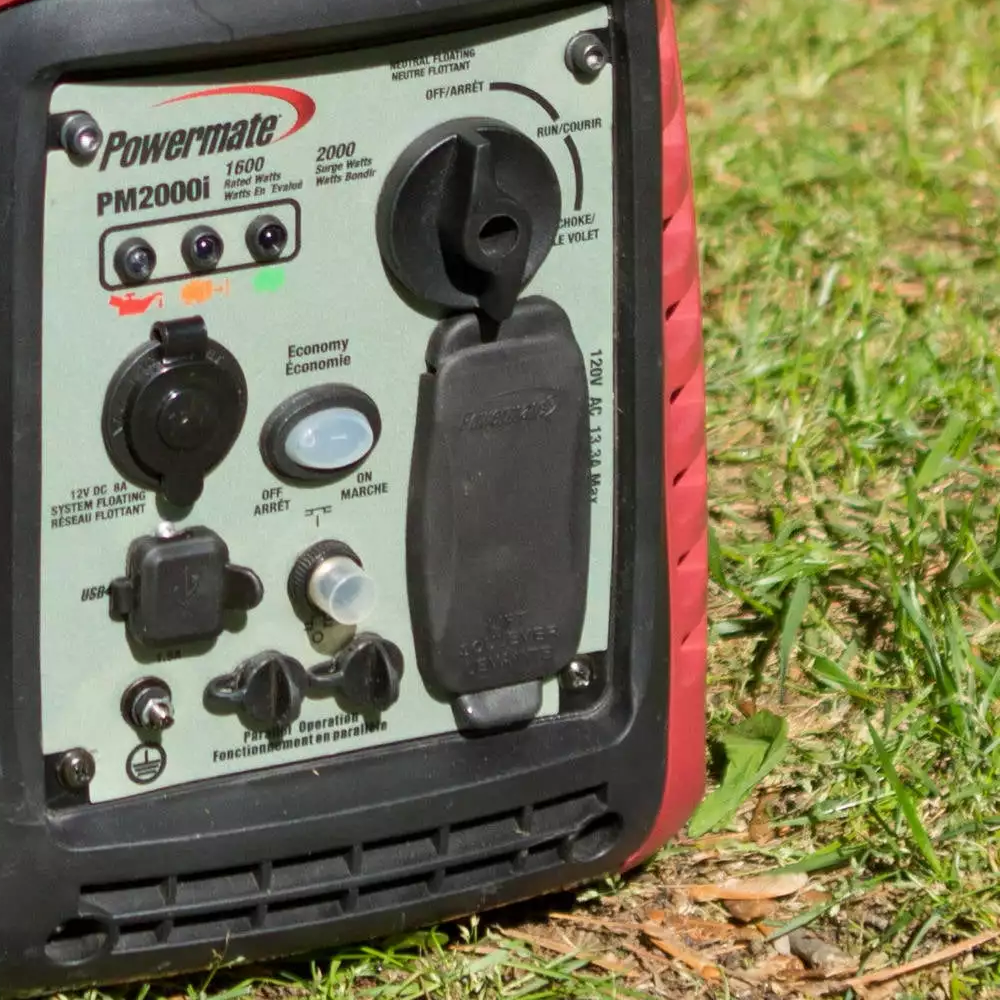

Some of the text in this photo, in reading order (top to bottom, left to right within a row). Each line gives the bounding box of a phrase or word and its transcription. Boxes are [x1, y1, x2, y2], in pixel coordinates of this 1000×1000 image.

[390, 49, 475, 70] NEUTRAL FLOATING
[391, 60, 471, 81] NEUTRE FLOTTANT
[537, 117, 602, 138] RUN/COURIR
[99, 112, 280, 172] Powermate
[316, 141, 356, 162] 2000
[225, 156, 264, 176] 1600
[316, 157, 373, 174] Surge Watts
[224, 172, 281, 189] Rated Watts
[316, 174, 342, 187] Watts
[97, 176, 211, 217] PM2000i
[224, 189, 251, 201] Watts
[568, 228, 599, 244] VOLET
[288, 338, 350, 358] Economy
[285, 354, 351, 376] Économie
[590, 349, 603, 386] 120V
[589, 397, 602, 417] AC
[357, 471, 373, 484] ON
[71, 481, 128, 501] 12V DC 8A
[262, 487, 283, 501] OFF
[340, 483, 388, 501] MARCHE
[51, 490, 146, 516] SYSTEM FLOATING
[95, 504, 146, 521] FLOTTANT
[81, 585, 106, 602] USB
[299, 712, 359, 733] Operation
[316, 731, 330, 743] en
